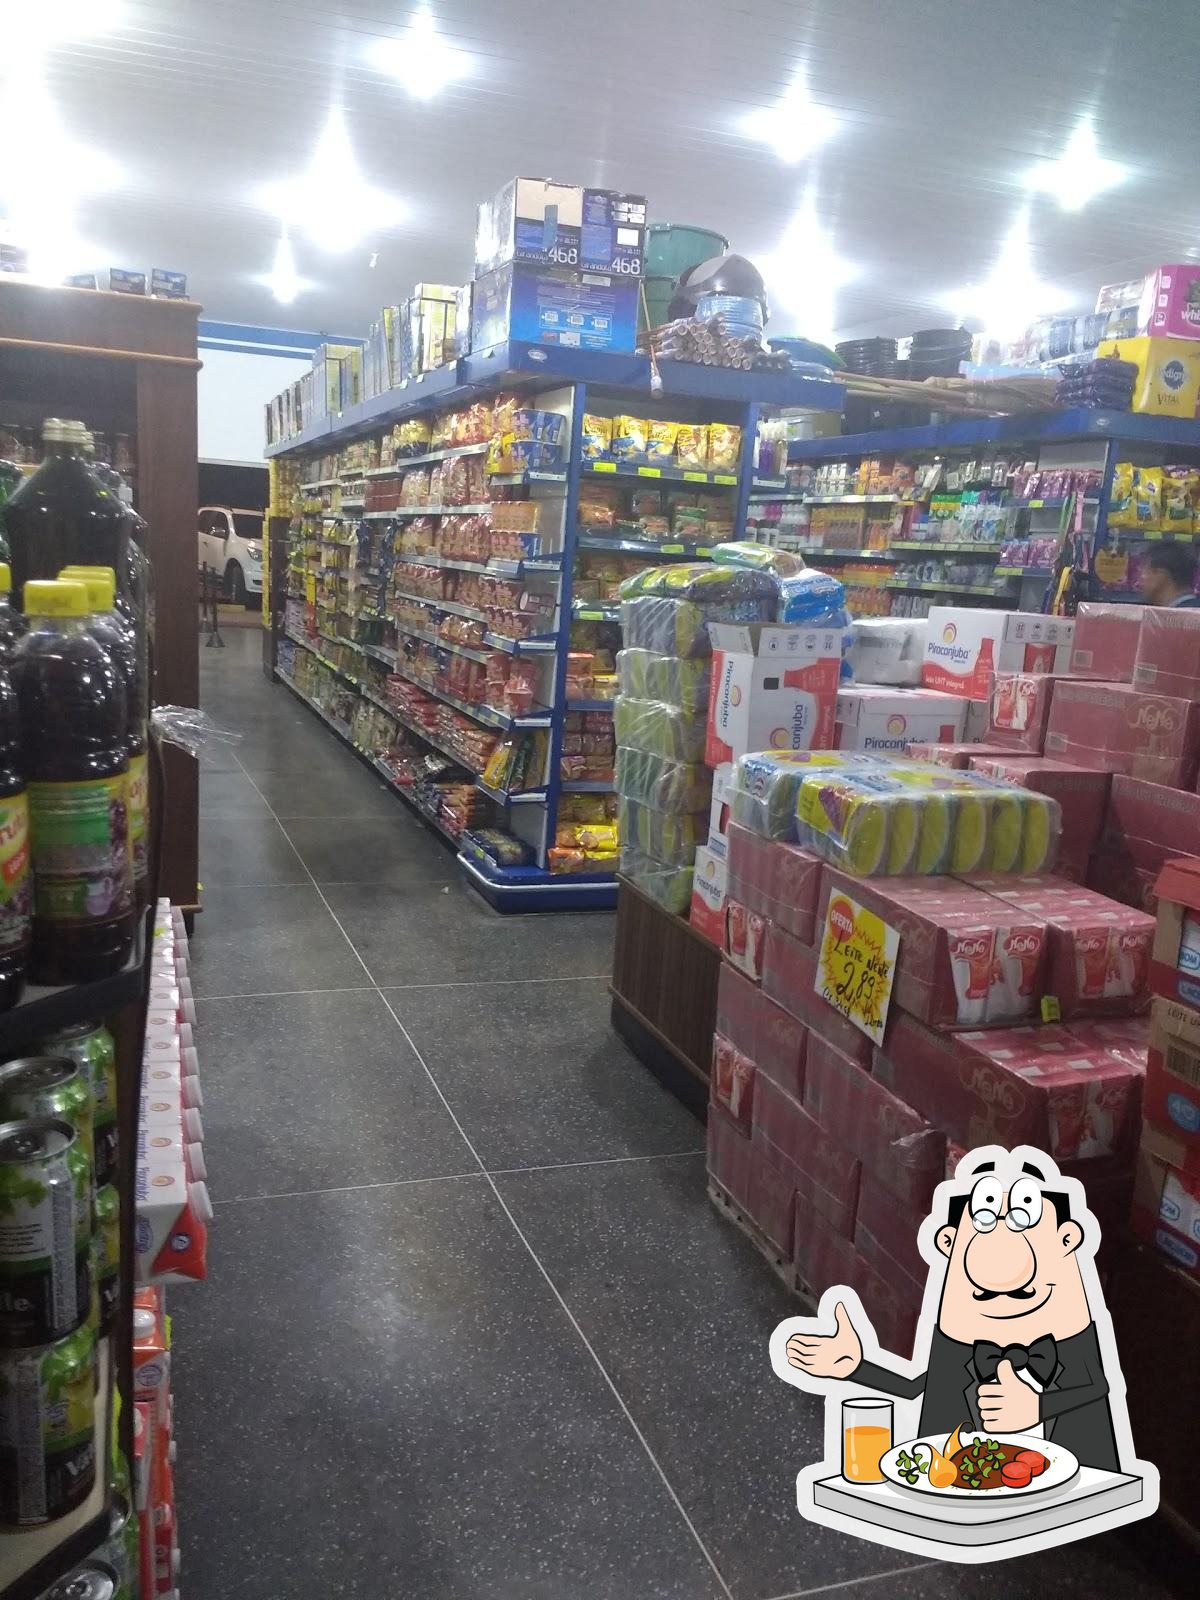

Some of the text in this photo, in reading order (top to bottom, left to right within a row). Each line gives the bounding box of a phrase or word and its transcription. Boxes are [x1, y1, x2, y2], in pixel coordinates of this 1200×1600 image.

[548, 247, 578, 265] 468
[611, 256, 641, 275] 468
[831, 910, 853, 933] OFERTA
